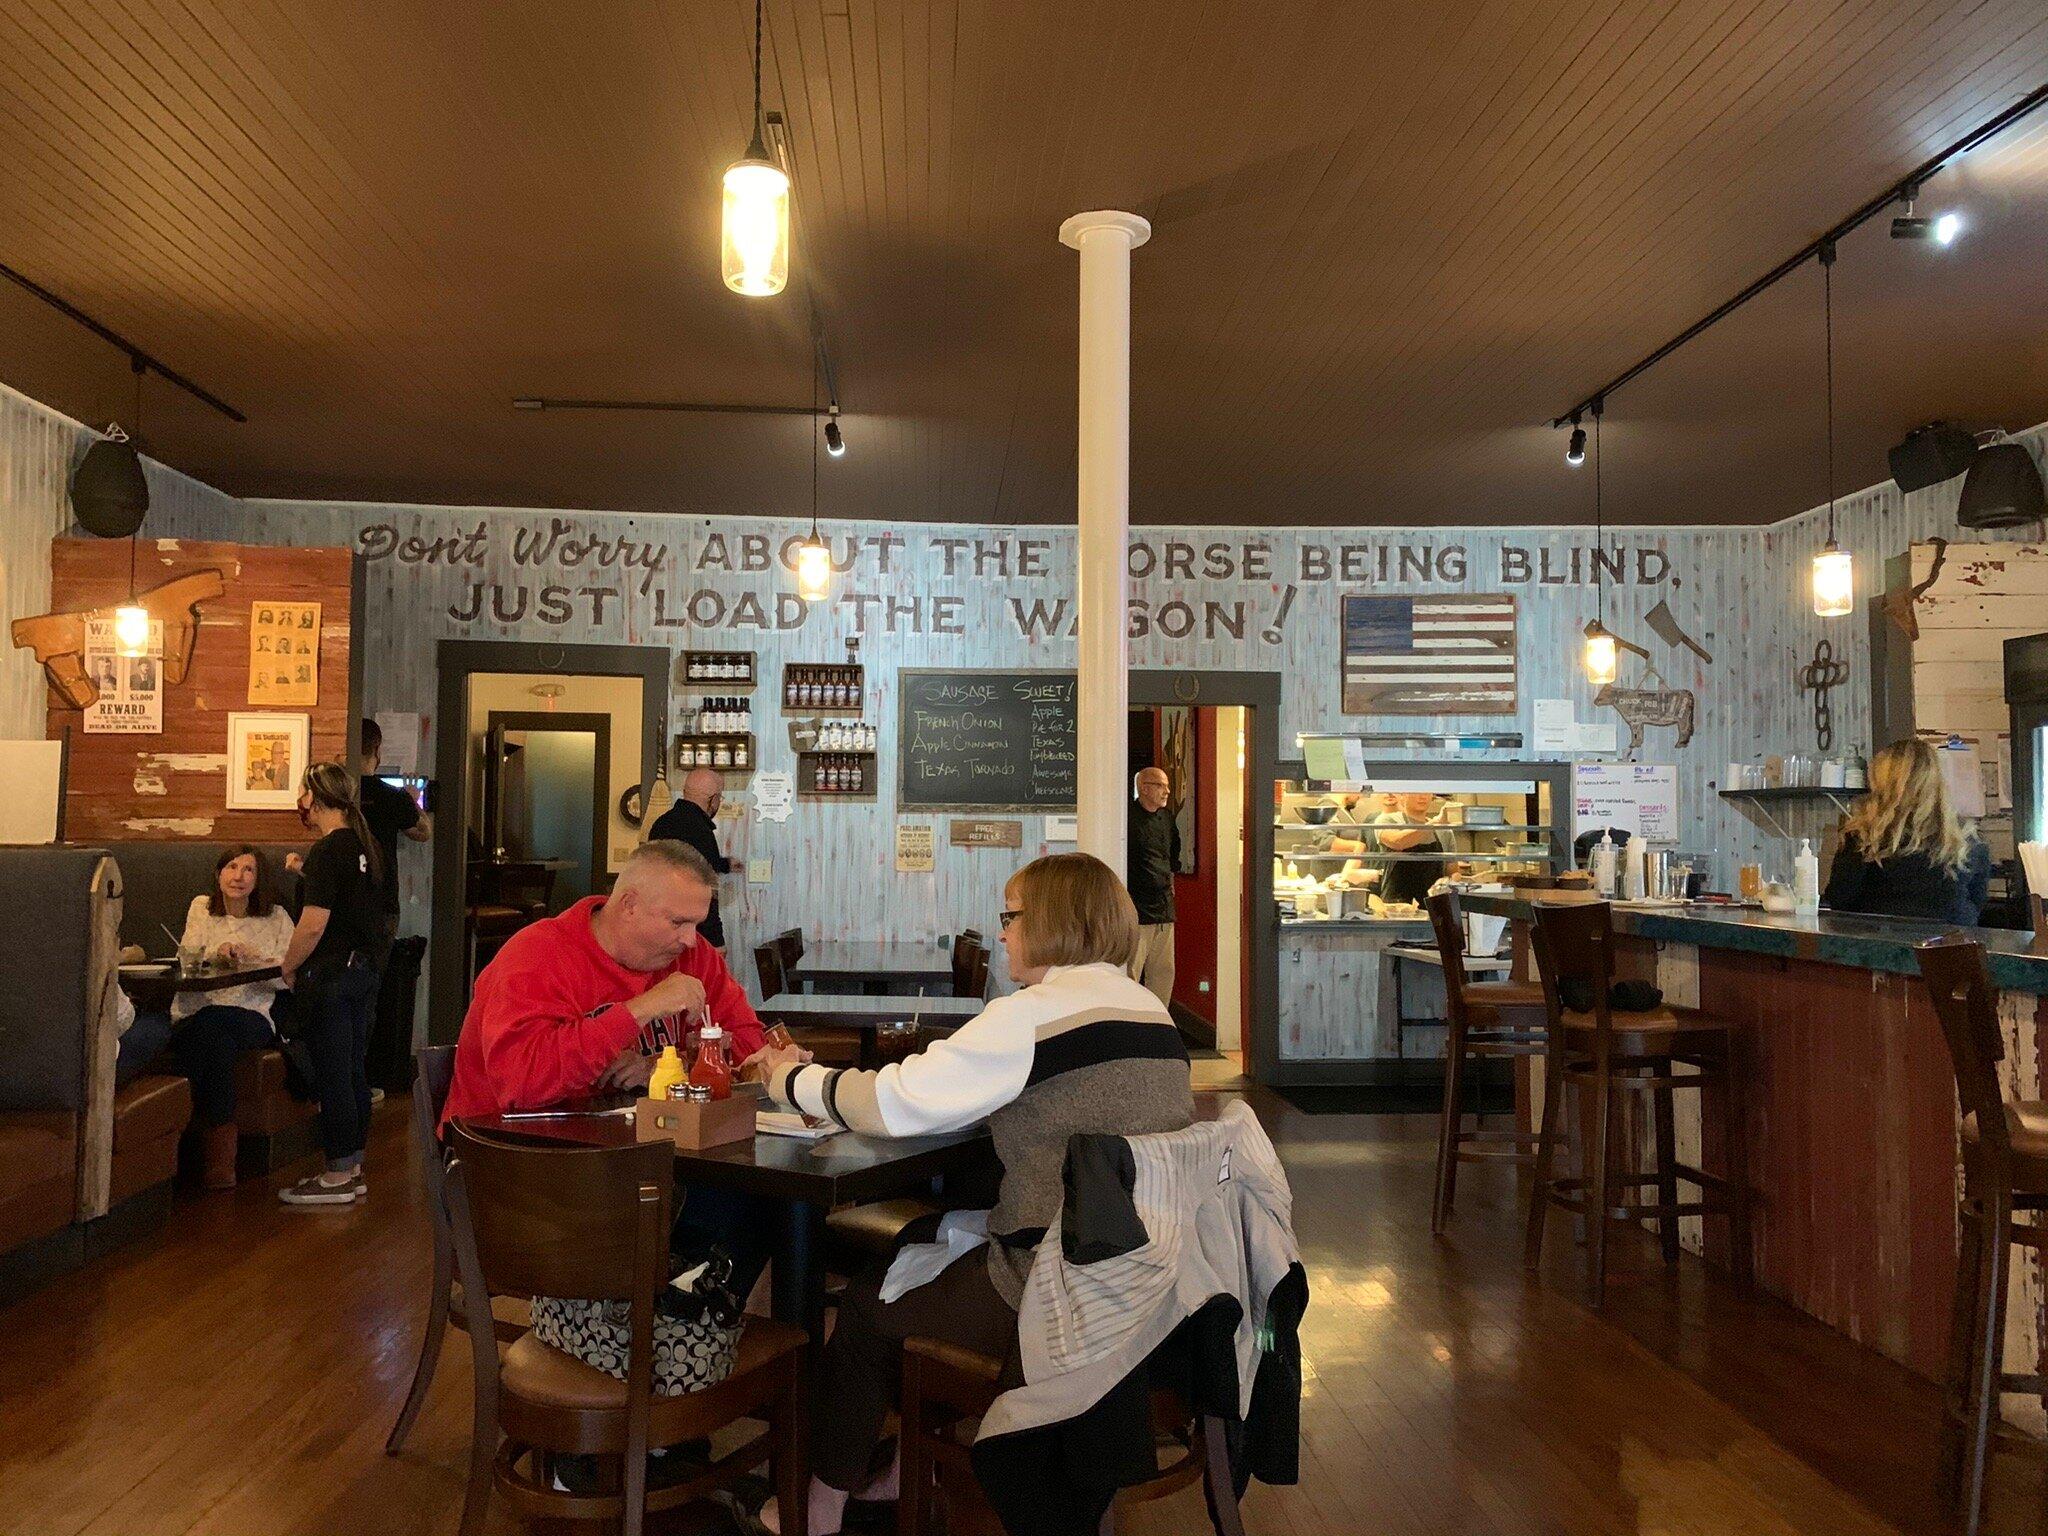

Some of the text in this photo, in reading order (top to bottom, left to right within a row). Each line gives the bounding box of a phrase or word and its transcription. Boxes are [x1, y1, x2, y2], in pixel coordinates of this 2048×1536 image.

[358, 517, 1683, 597] Don't Worry ABOUT THE ORSE BEING BLIND,
[448, 583, 619, 626] JUST
[653, 588, 809, 631] LOAD
[841, 593, 966, 634] THE
[922, 680, 1075, 706] SAUSAGE SWEET!
[99, 703, 146, 715] REWARD
[961, 711, 1002, 731] ONION
[1066, 719, 1076, 733] 2
